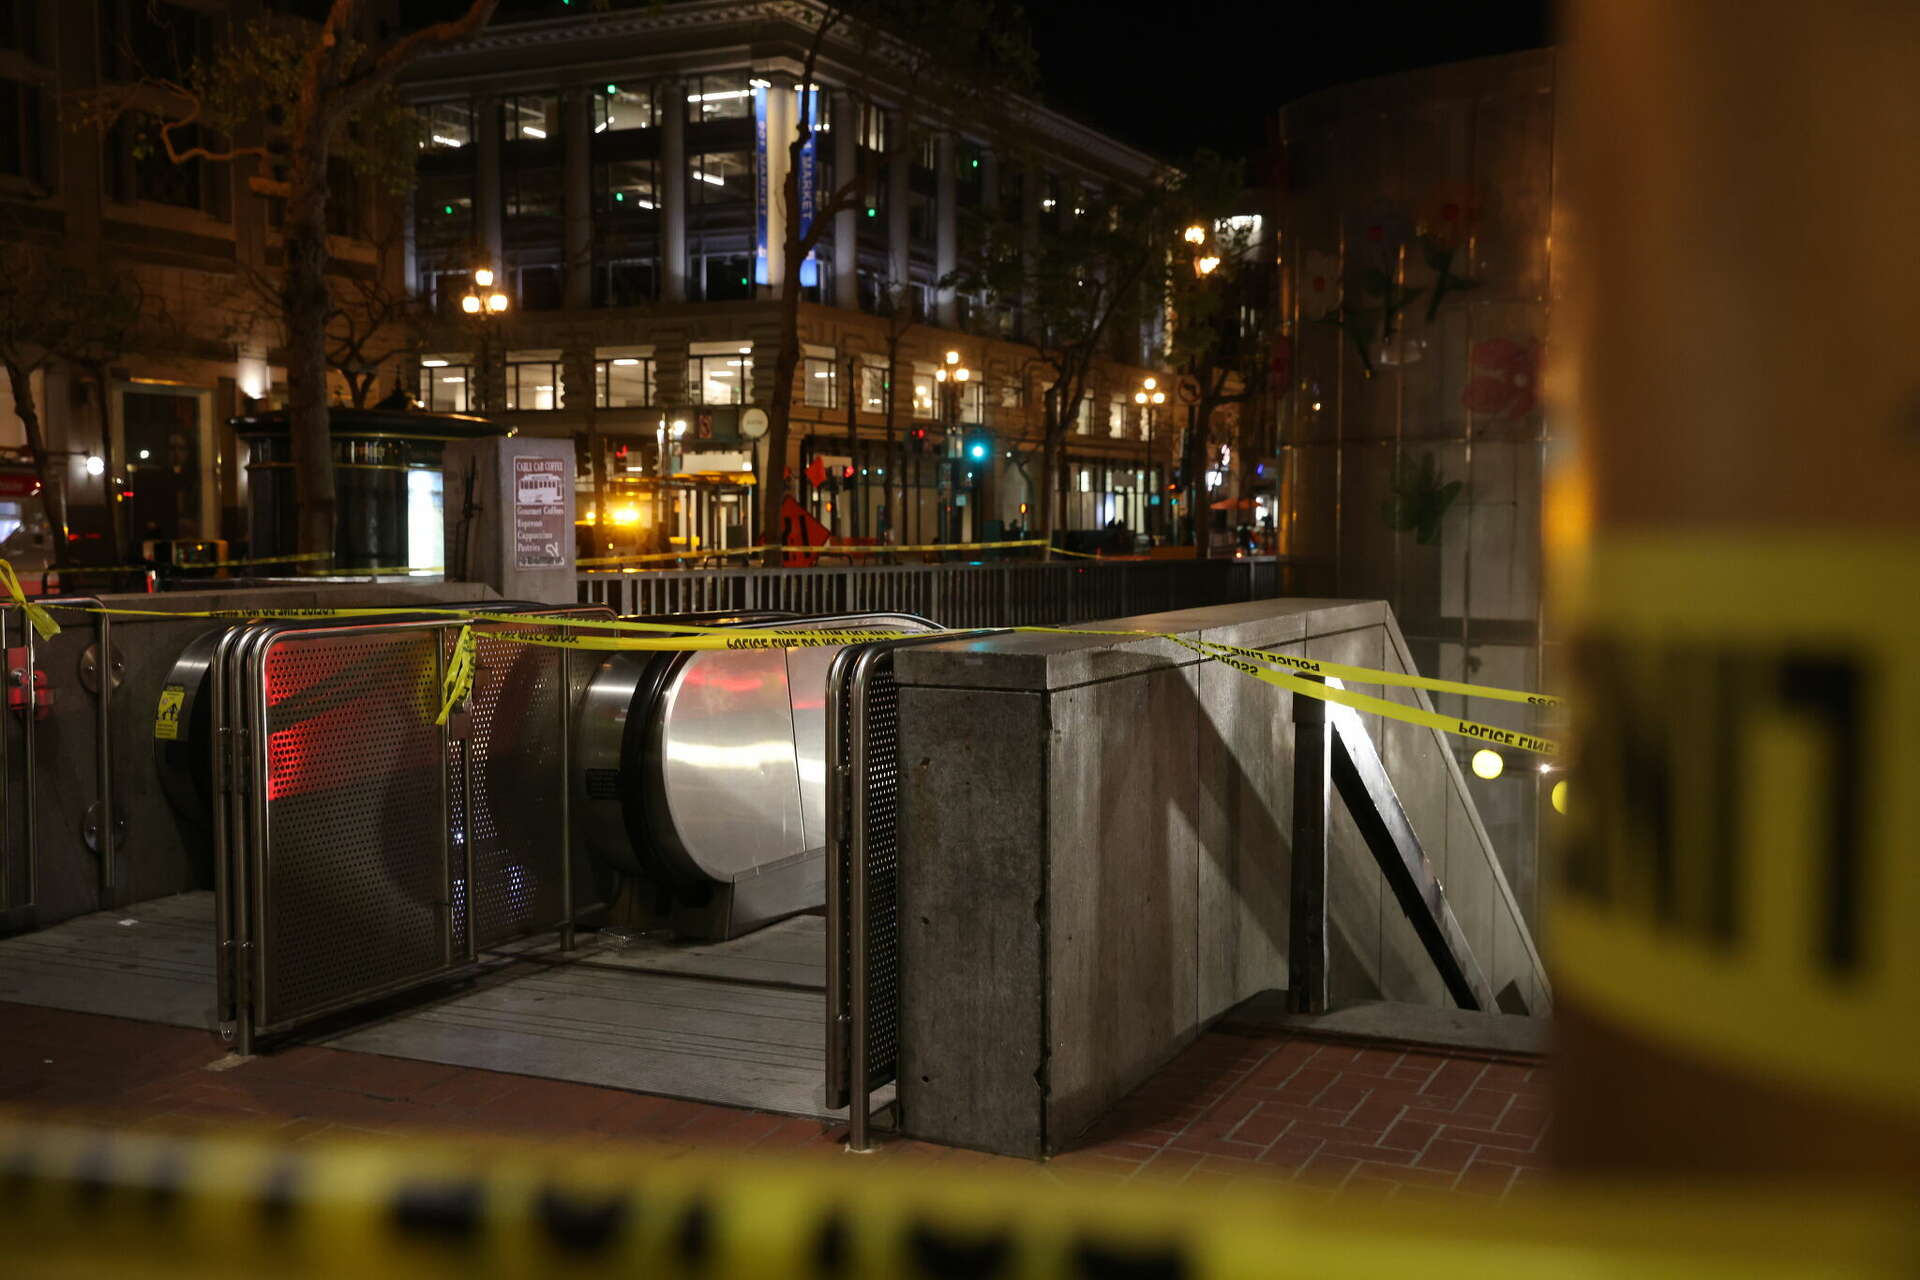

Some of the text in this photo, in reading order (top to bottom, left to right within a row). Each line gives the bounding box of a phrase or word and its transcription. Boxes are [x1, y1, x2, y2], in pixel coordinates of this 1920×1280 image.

[801, 157, 813, 220] MARKET
[533, 462, 545, 473] CAR
[1230, 646, 1265, 663] LINE
[1266, 653, 1321, 673] POLICE
